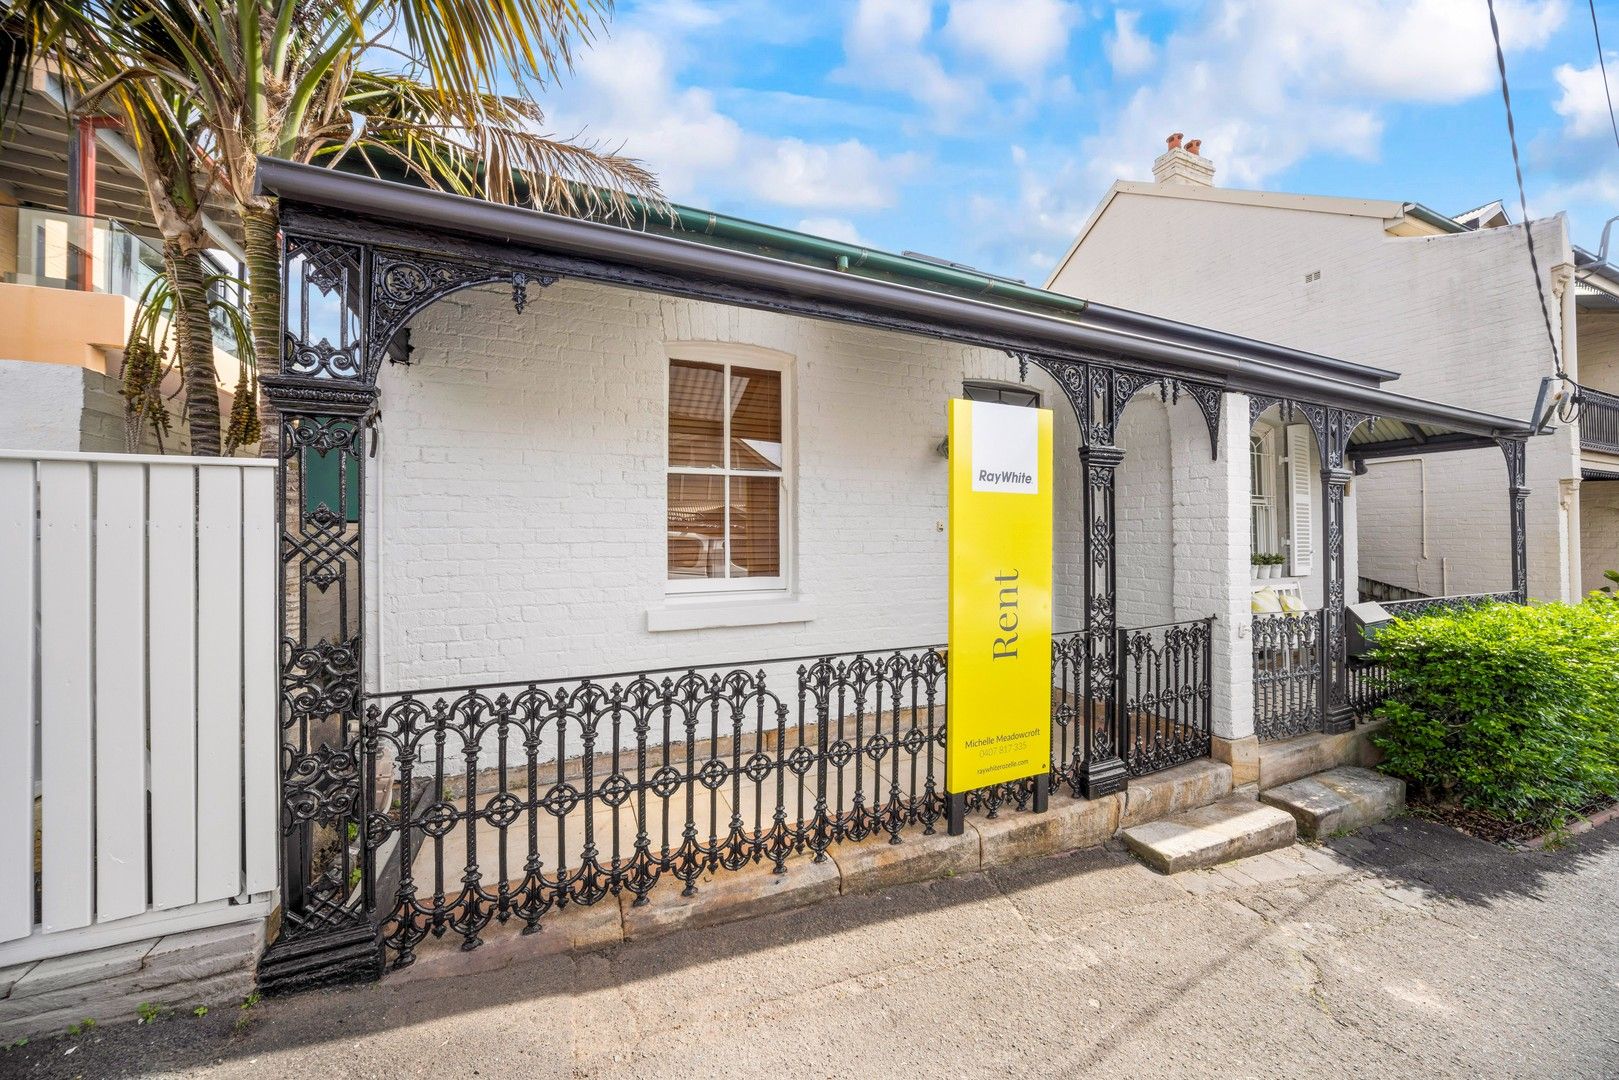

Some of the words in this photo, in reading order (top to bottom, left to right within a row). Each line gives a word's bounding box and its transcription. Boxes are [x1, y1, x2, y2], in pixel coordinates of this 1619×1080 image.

[992, 568, 1019, 661] Rent
[965, 737, 995, 749] Michelle
[996, 728, 1040, 743] Meadowcroft
[977, 759, 1029, 775] raywhiterozelle.com
